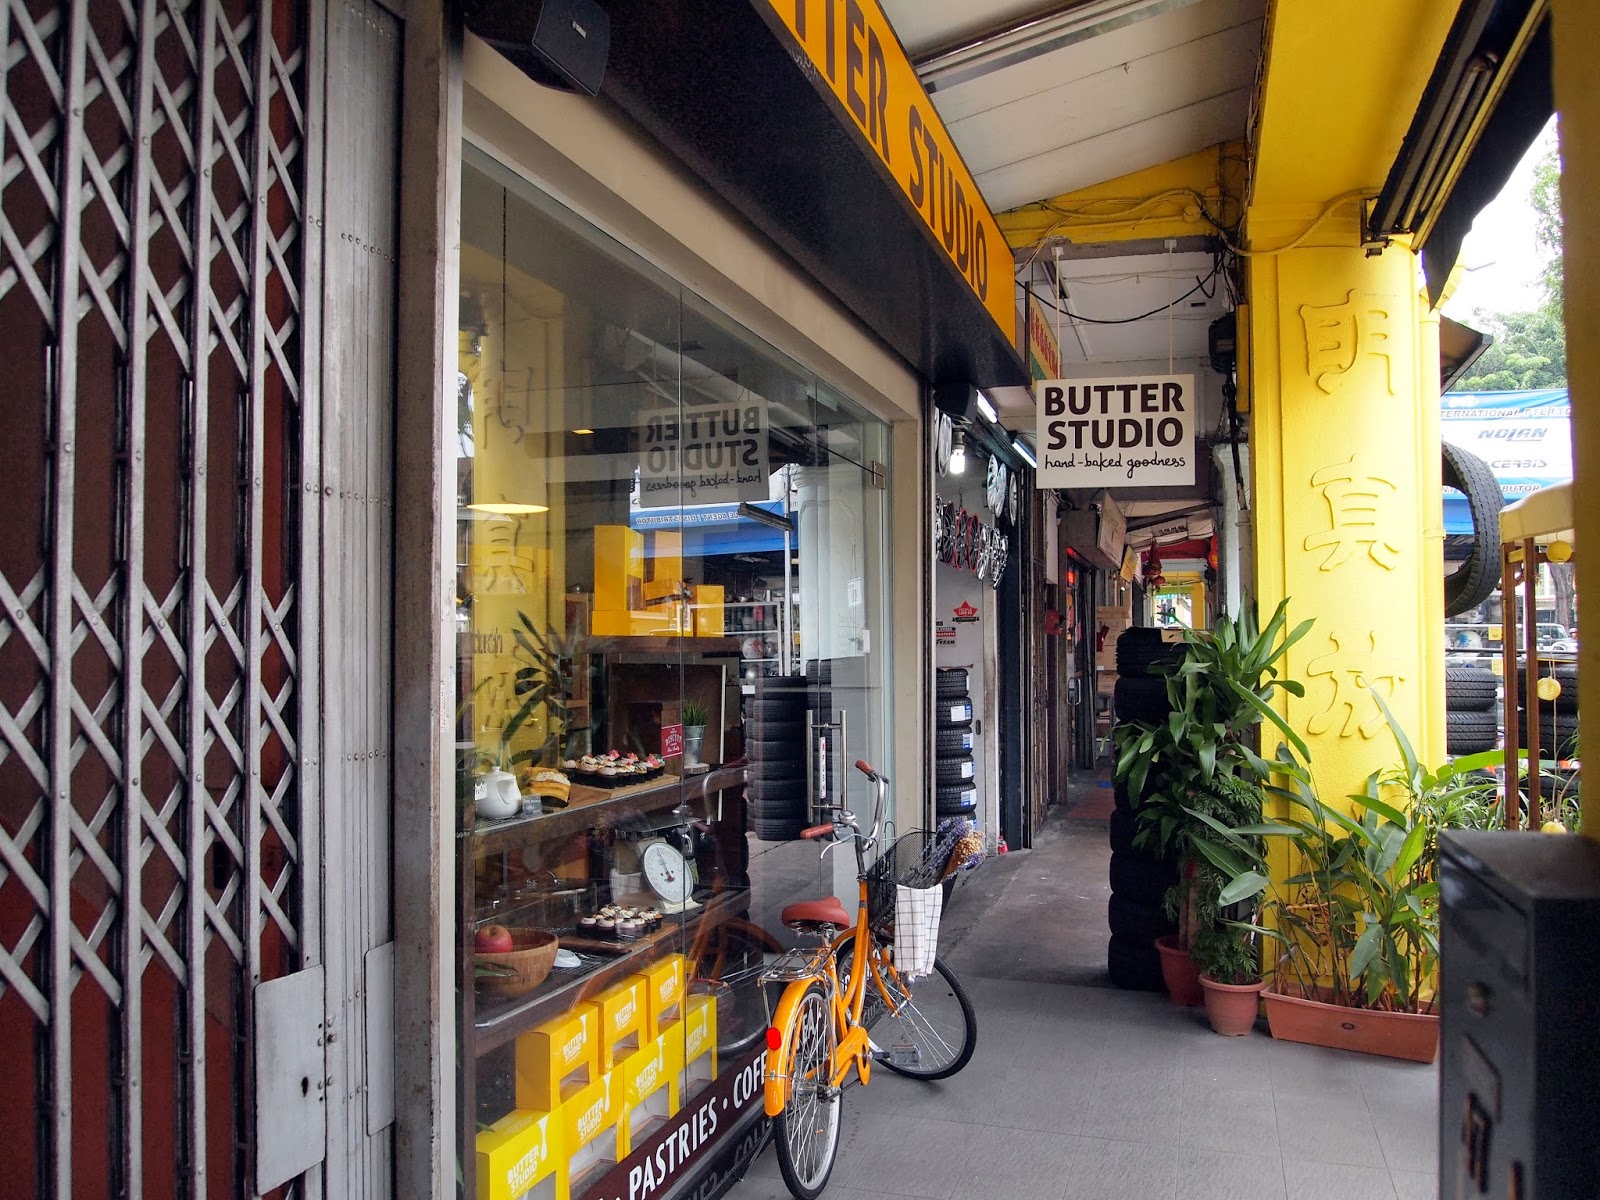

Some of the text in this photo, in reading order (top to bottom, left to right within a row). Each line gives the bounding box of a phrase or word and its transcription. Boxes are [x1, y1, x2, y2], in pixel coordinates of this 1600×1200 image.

[795, 0, 987, 303] TER STUDIO
[1045, 383, 1185, 416] BUTTER
[1047, 417, 1184, 450] STUDIO
[1045, 451, 1186, 479] hand-baked goodness
[563, 1032, 582, 1055] BUTTER
[636, 1057, 657, 1088] BUTTER
[578, 1097, 604, 1131] BUTTER
[580, 1111, 602, 1141] STUDIO
[508, 1144, 539, 1184] BUTTER
[629, 1096, 718, 1200] PASTRIES
[511, 1160, 538, 1193] STUDIO
